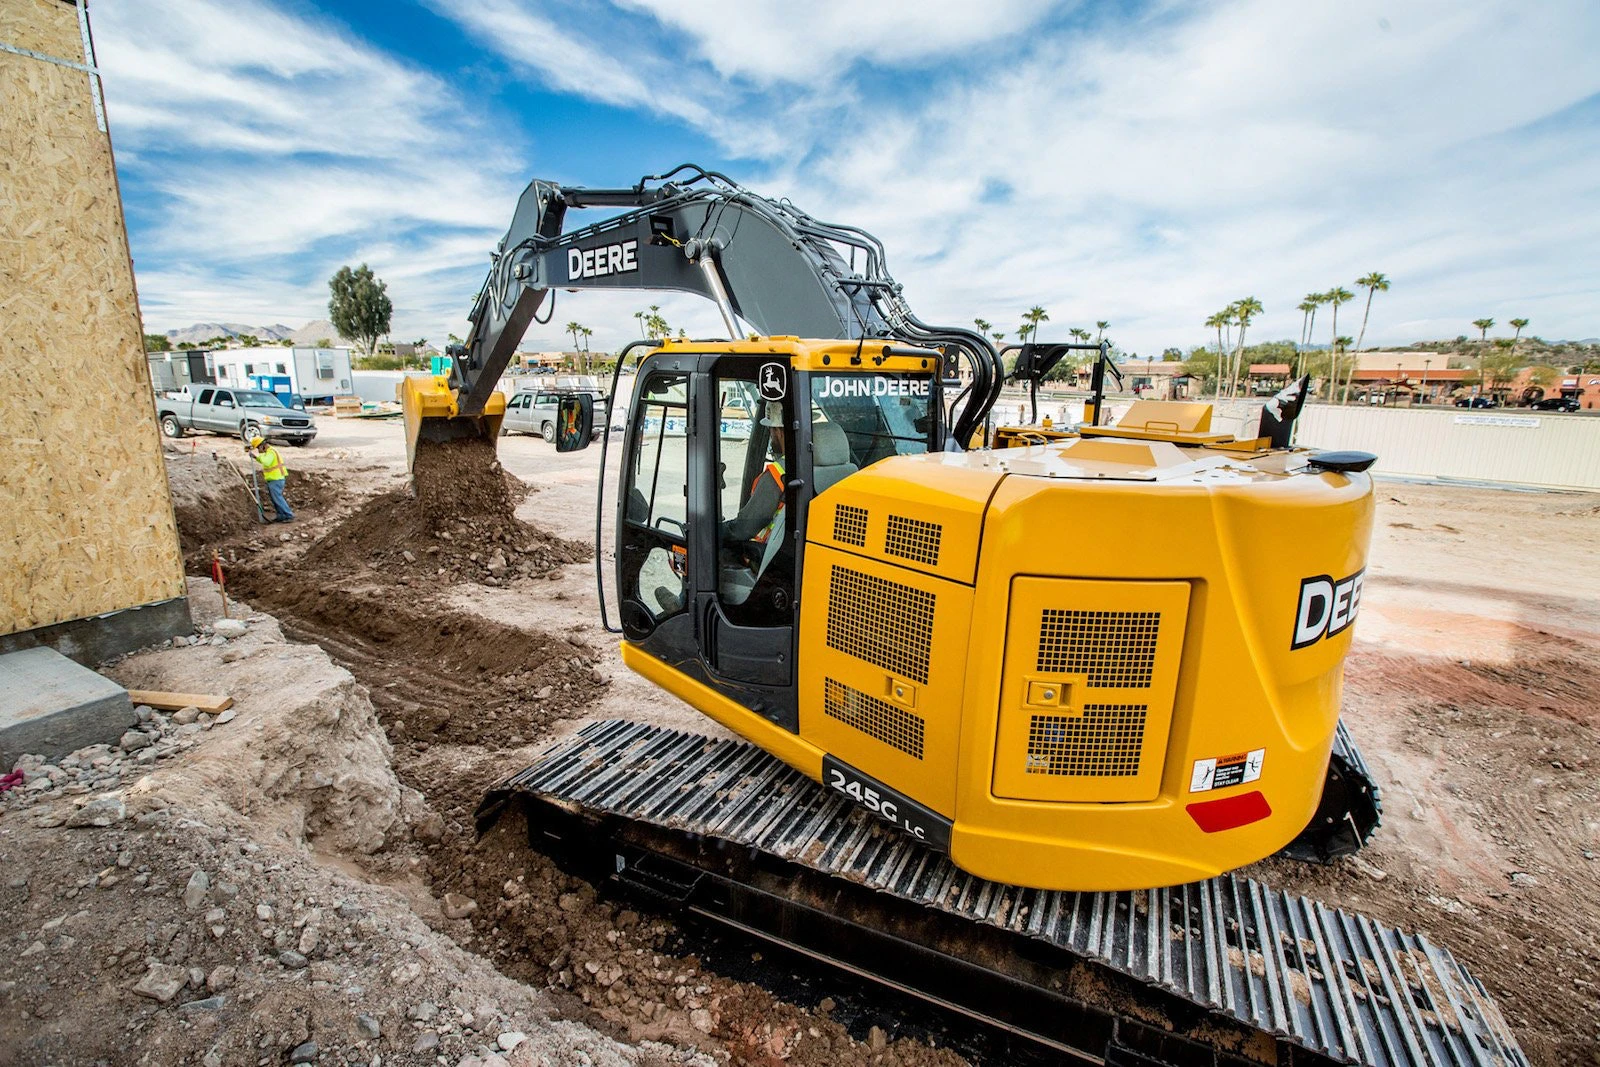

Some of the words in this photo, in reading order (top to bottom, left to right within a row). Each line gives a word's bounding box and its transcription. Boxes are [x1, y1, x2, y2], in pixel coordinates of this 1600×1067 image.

[568, 241, 637, 280] DEERE
[819, 376, 870, 397] JOHN
[874, 376, 929, 396] DEERE
[831, 769, 897, 822] 245G
[905, 820, 925, 839] LC
